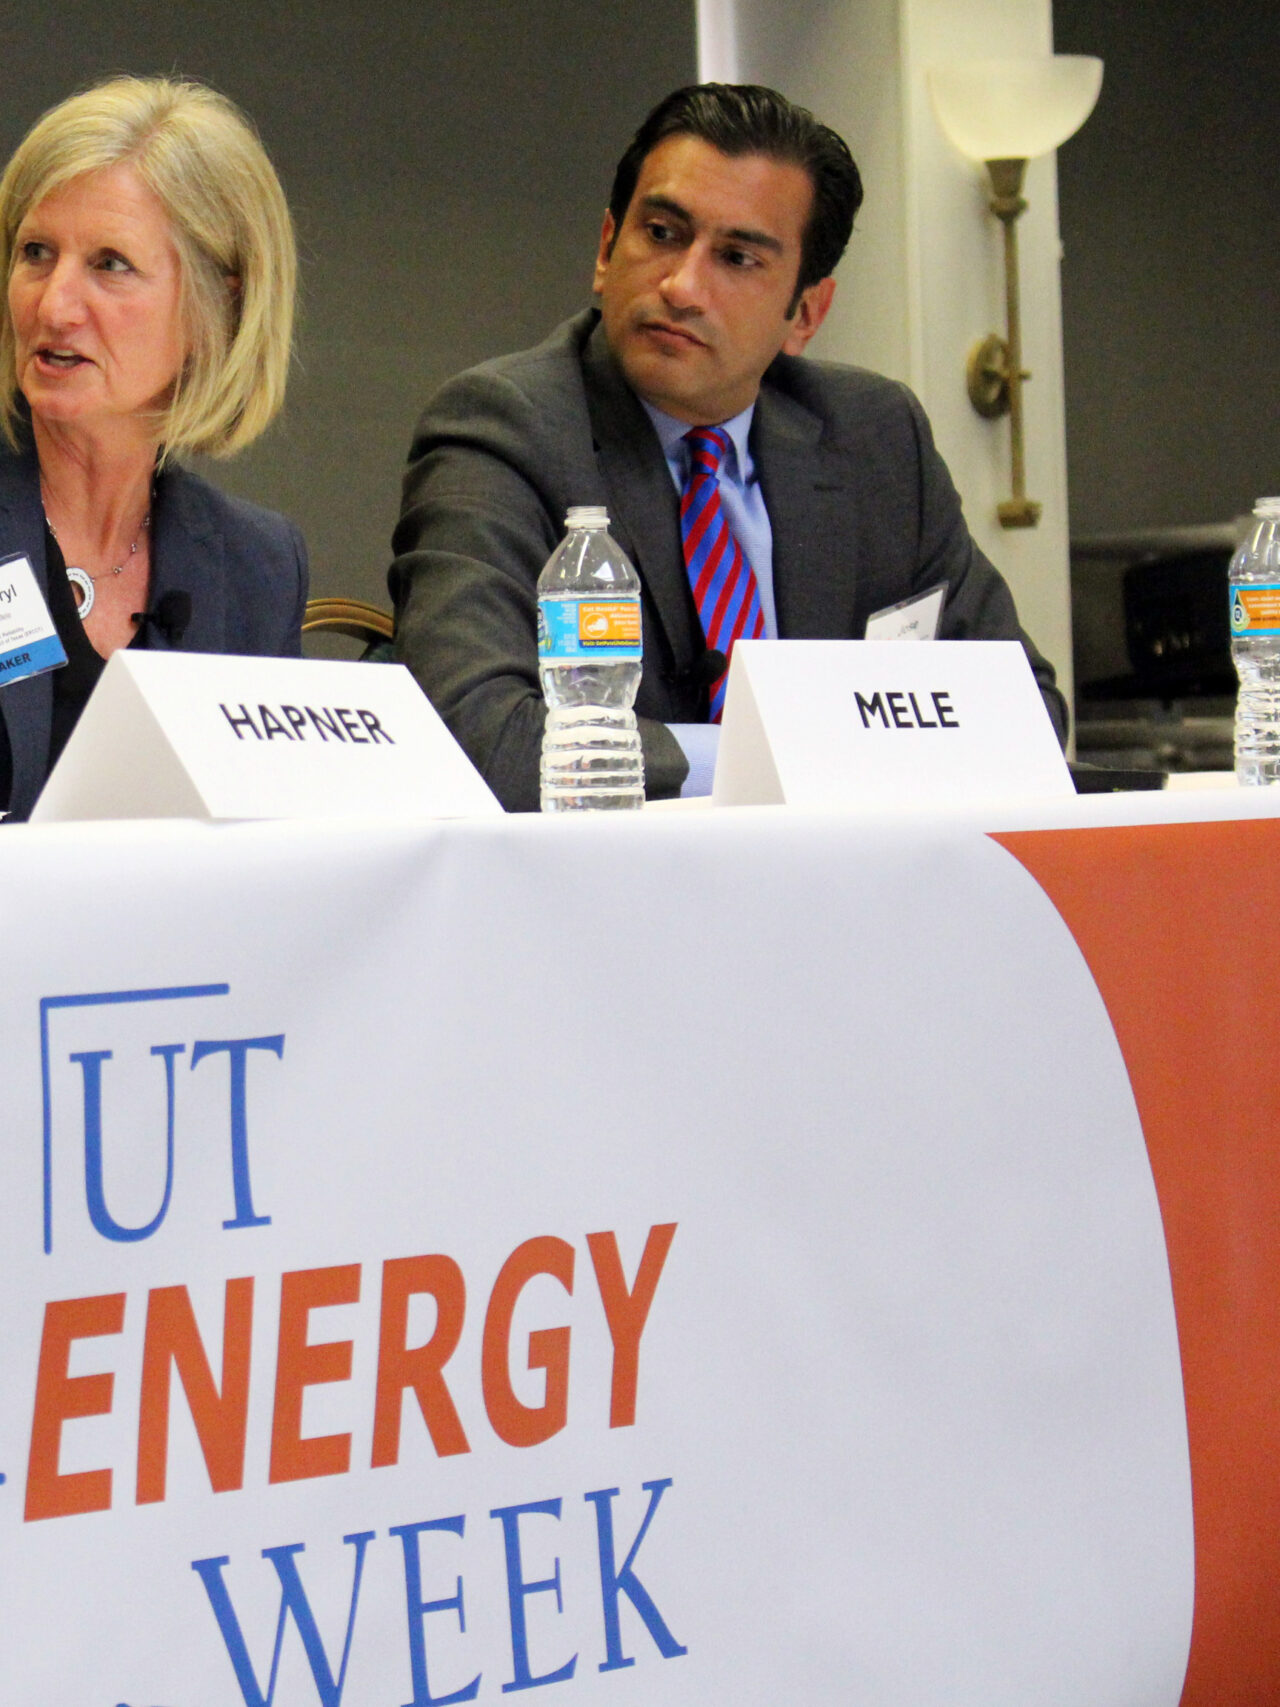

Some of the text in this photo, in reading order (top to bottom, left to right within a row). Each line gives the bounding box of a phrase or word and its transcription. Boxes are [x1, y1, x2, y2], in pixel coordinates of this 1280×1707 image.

[218, 703, 396, 745] HAPNER
[853, 691, 960, 729] MELE
[69, 1034, 286, 1243] UT
[23, 1222, 678, 1523] ENERGY
[191, 1477, 688, 1707] WEEK
